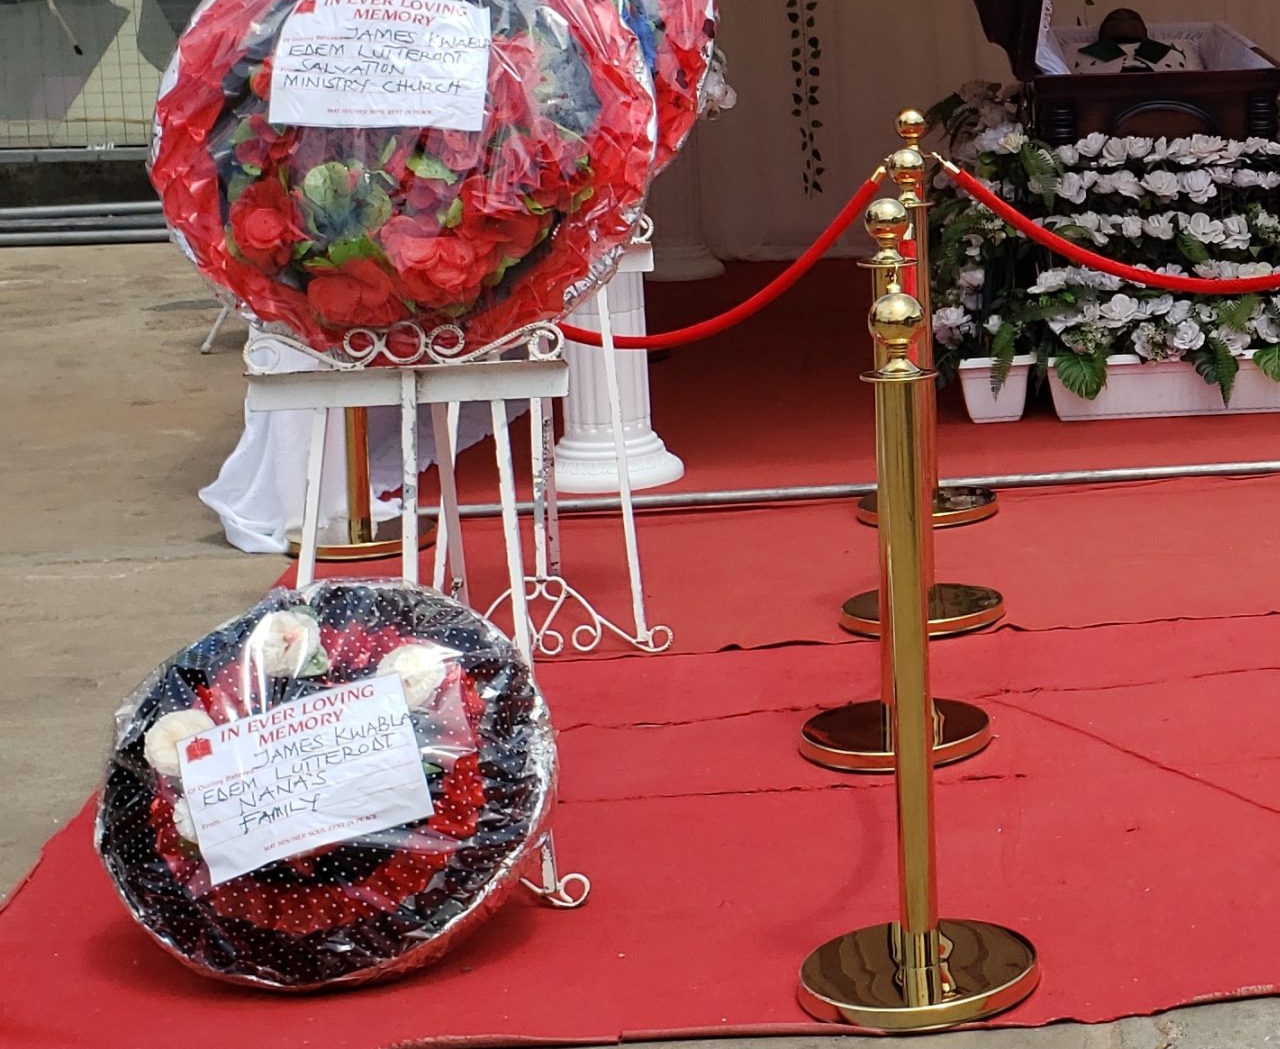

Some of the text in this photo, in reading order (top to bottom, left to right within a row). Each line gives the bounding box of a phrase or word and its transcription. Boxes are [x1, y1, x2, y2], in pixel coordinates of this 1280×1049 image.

[342, 27, 416, 45] JAMES
[353, 8, 436, 27] MEMORY
[289, 44, 344, 56] EDEM
[296, 59, 407, 76] SALVATION
[283, 74, 462, 96] MINISTRY CHURCH
[220, 684, 375, 743] IN EVER LOVING
[258, 709, 345, 747] MEMORY
[254, 712, 411, 770] JAMES KWABLA
[202, 732, 397, 807] EDEM LUTTERODT
[239, 771, 327, 816] NANA'S
[239, 793, 321, 835] FAMILY
